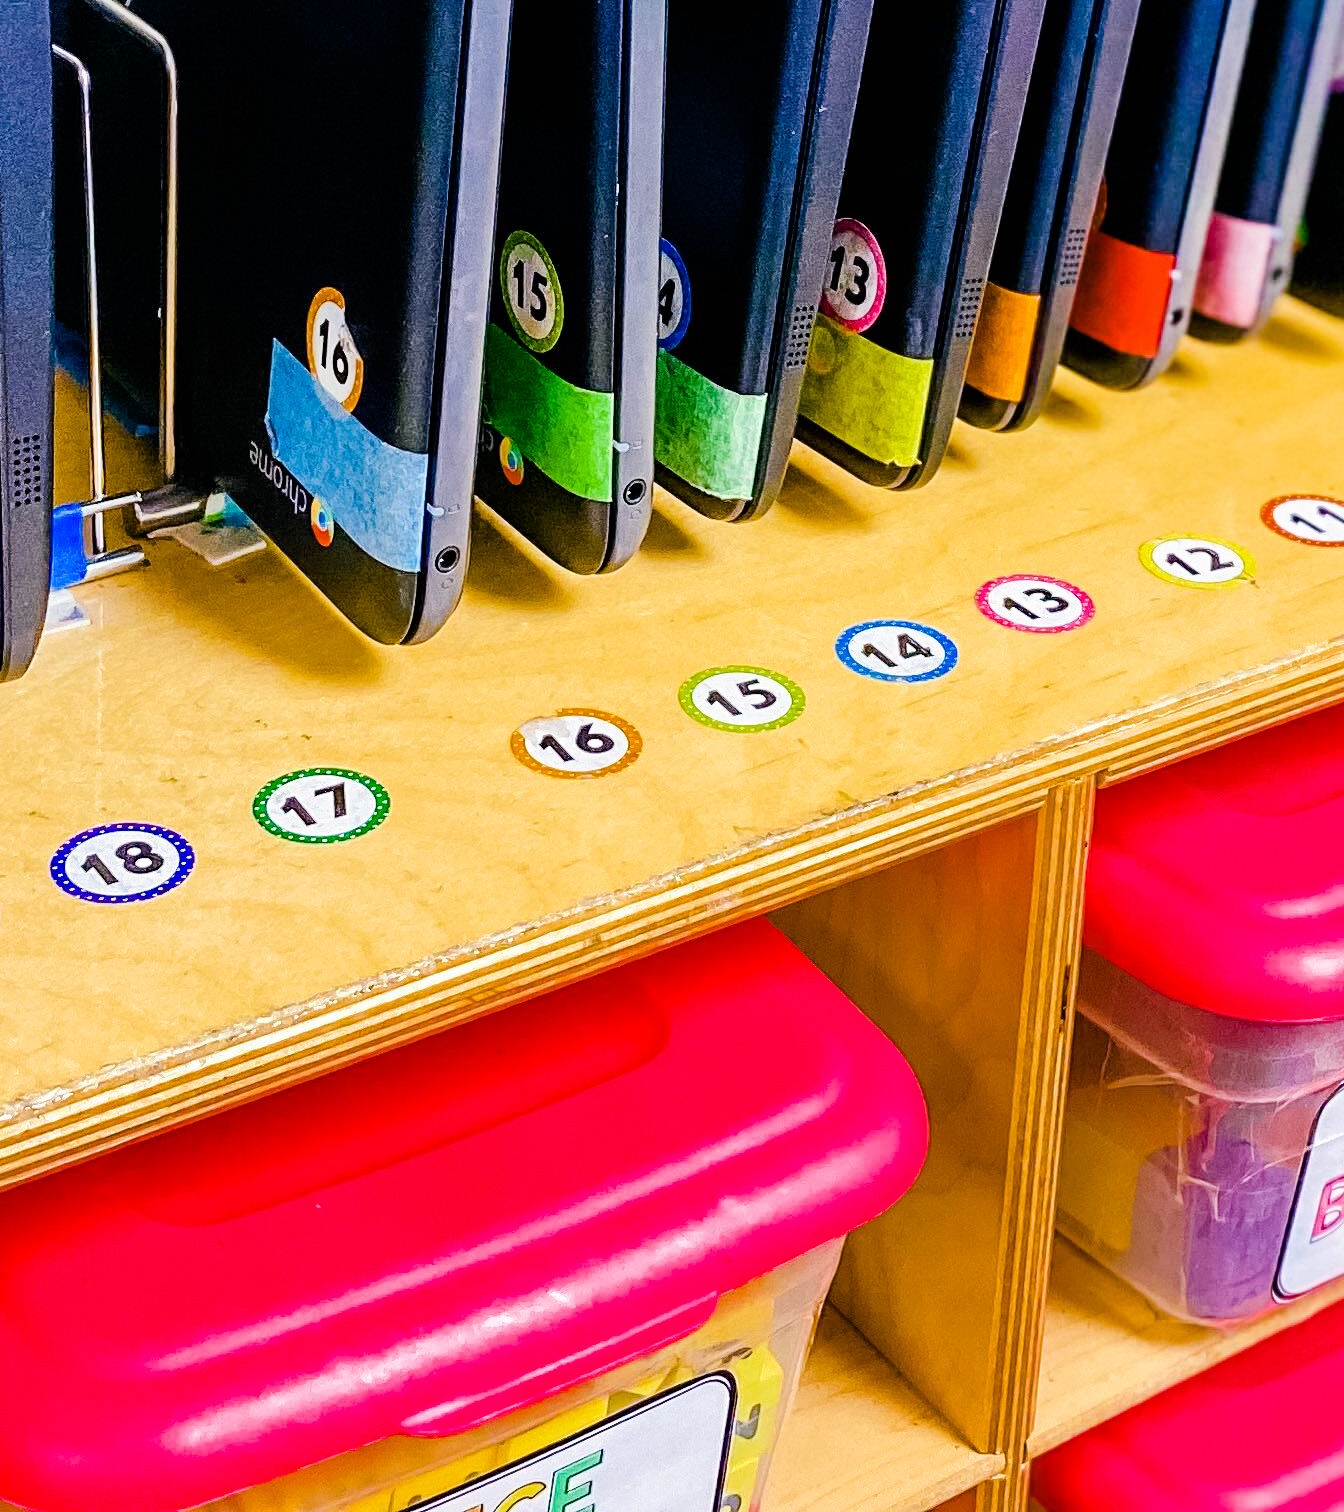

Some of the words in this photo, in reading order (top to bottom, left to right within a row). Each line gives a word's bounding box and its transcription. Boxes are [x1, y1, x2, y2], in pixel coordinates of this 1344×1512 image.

[512, 260, 548, 321] 15
[830, 246, 869, 305] 13
[658, 279, 676, 326] 4
[320, 318, 352, 384] 16
[249, 441, 307, 514] chrome
[1166, 547, 1234, 576] 12
[1004, 588, 1069, 620] 13
[861, 634, 935, 668] 14
[707, 679, 777, 716] 15
[539, 722, 615, 762] 16
[279, 782, 347, 826] 17
[80, 841, 164, 885] 18
